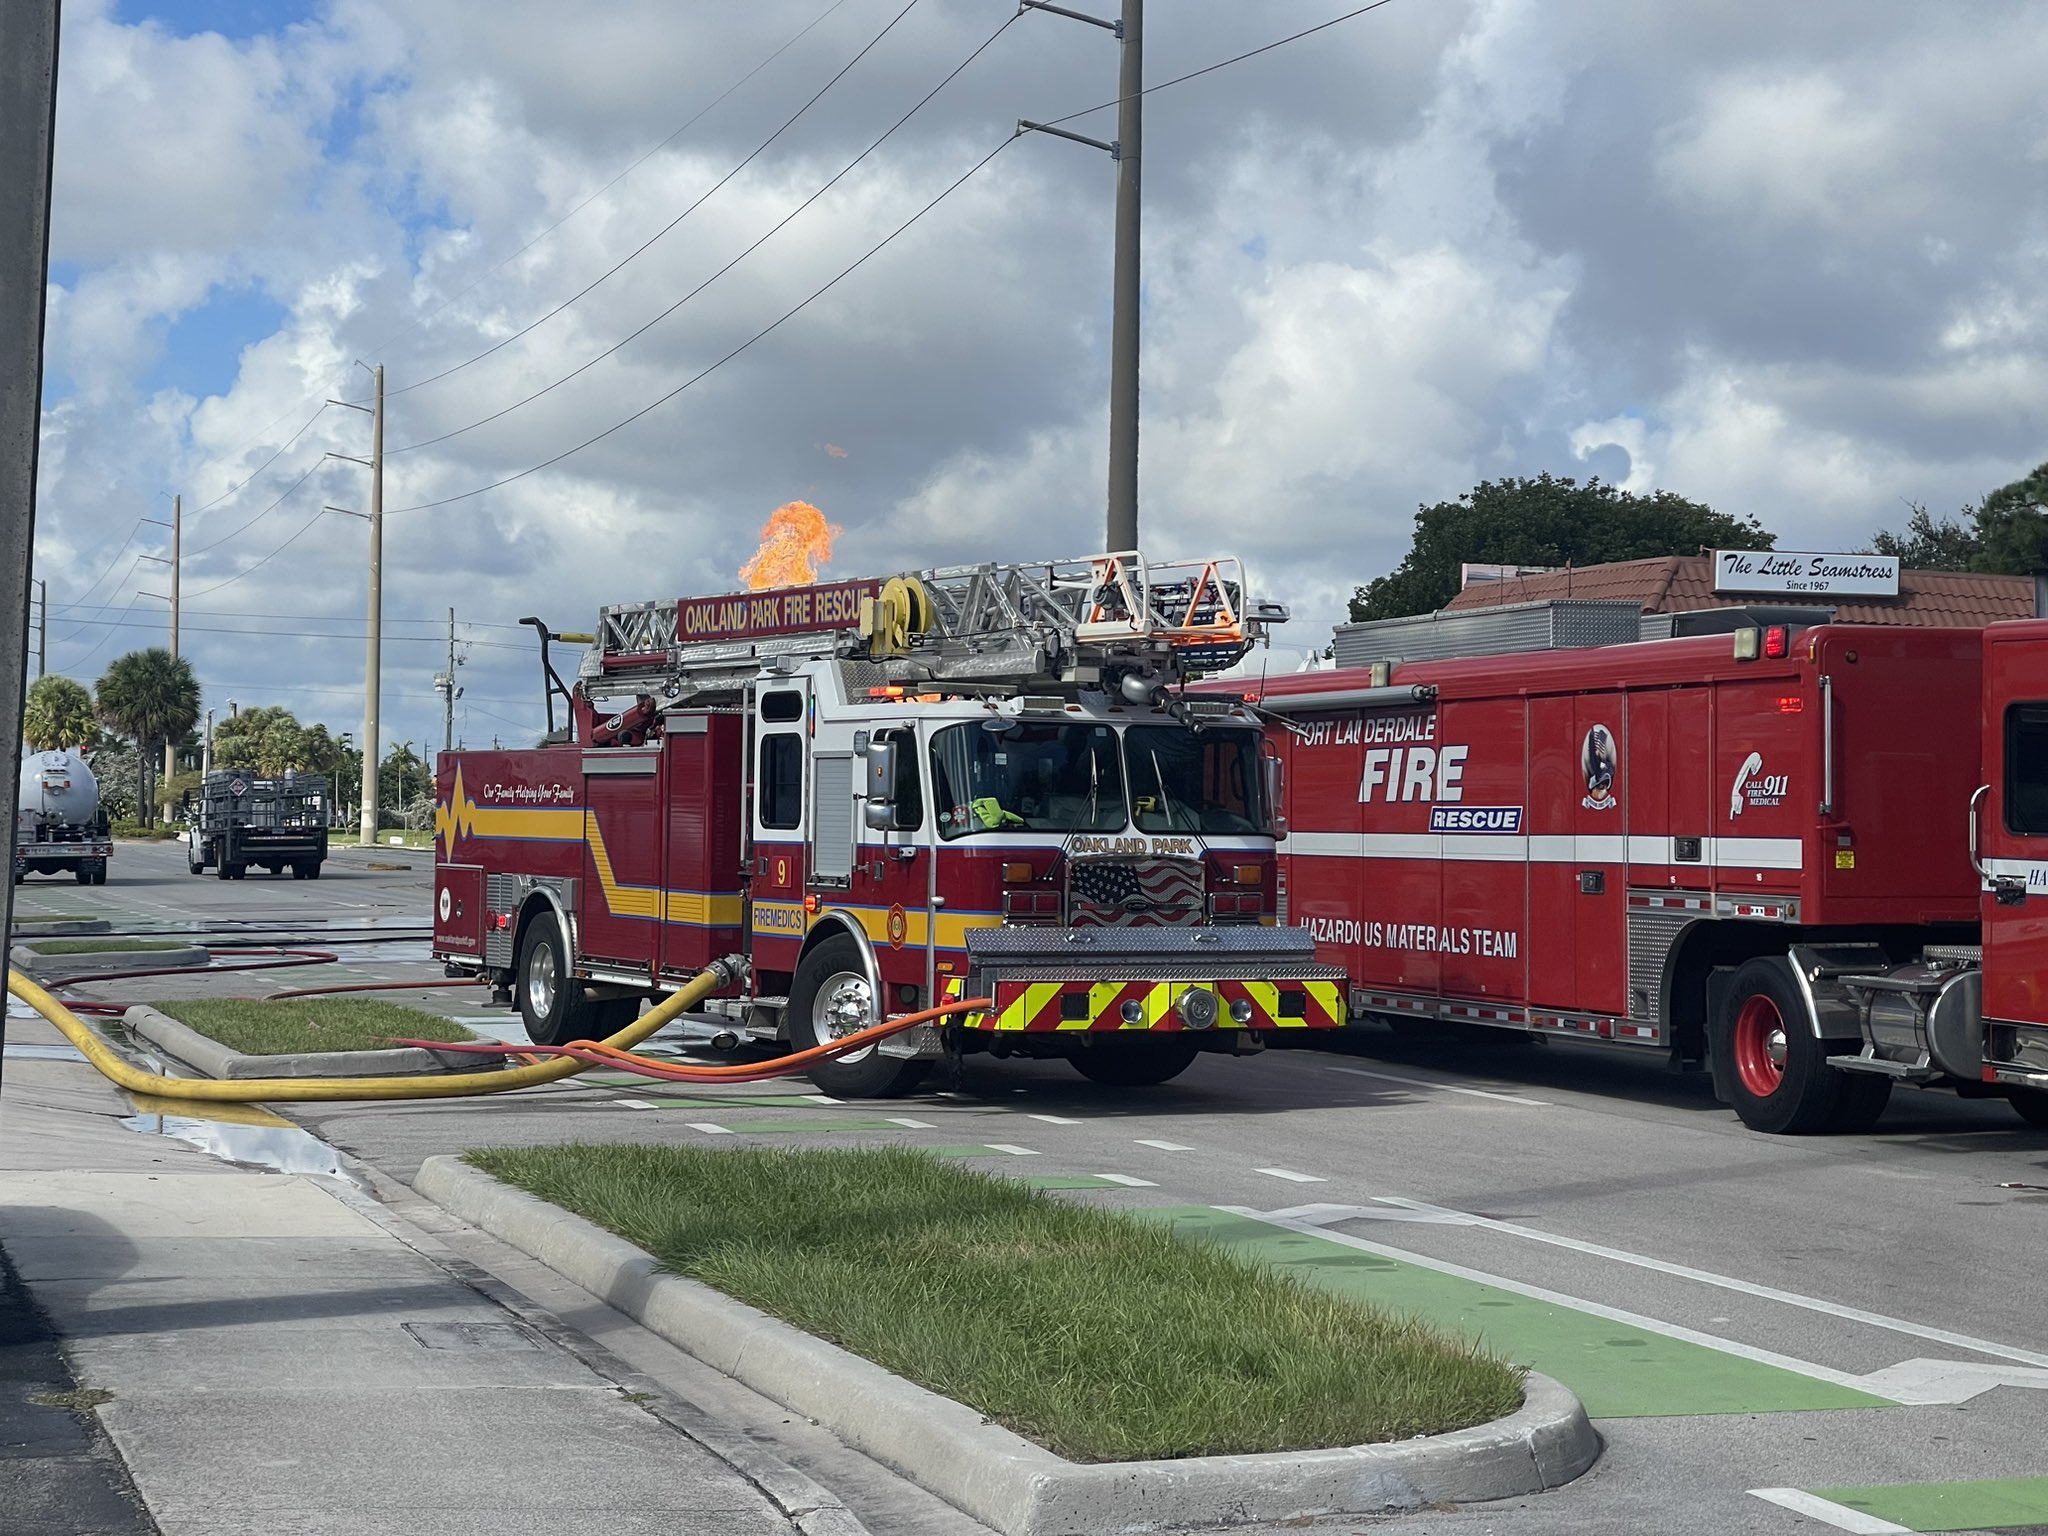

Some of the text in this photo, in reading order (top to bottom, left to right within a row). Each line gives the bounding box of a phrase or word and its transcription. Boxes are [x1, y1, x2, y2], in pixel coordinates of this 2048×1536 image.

[1724, 554, 1893, 579] The Little Seamstress
[1786, 580, 1830, 591] Since 1967
[685, 601, 748, 634] OAKLAND
[751, 597, 780, 629] PARK
[784, 593, 811, 625] FIRE
[1296, 714, 1437, 746] FORT LAUDERDALE
[1358, 745, 1469, 802] FIRE
[484, 784, 574, 803] Our Family Helping Your Family
[1745, 775, 1788, 796] CALL 911
[1747, 789, 1763, 797] FIRE
[1749, 797, 1781, 806] MEDICAL
[1433, 811, 1519, 829] RESCUE
[1072, 836, 1194, 855] OAKLAND PARK
[778, 859, 786, 885] 9
[754, 908, 802, 930] FIREMEDICS
[1386, 923, 1470, 955] MATERALS
[1472, 929, 1517, 958] TEAM
